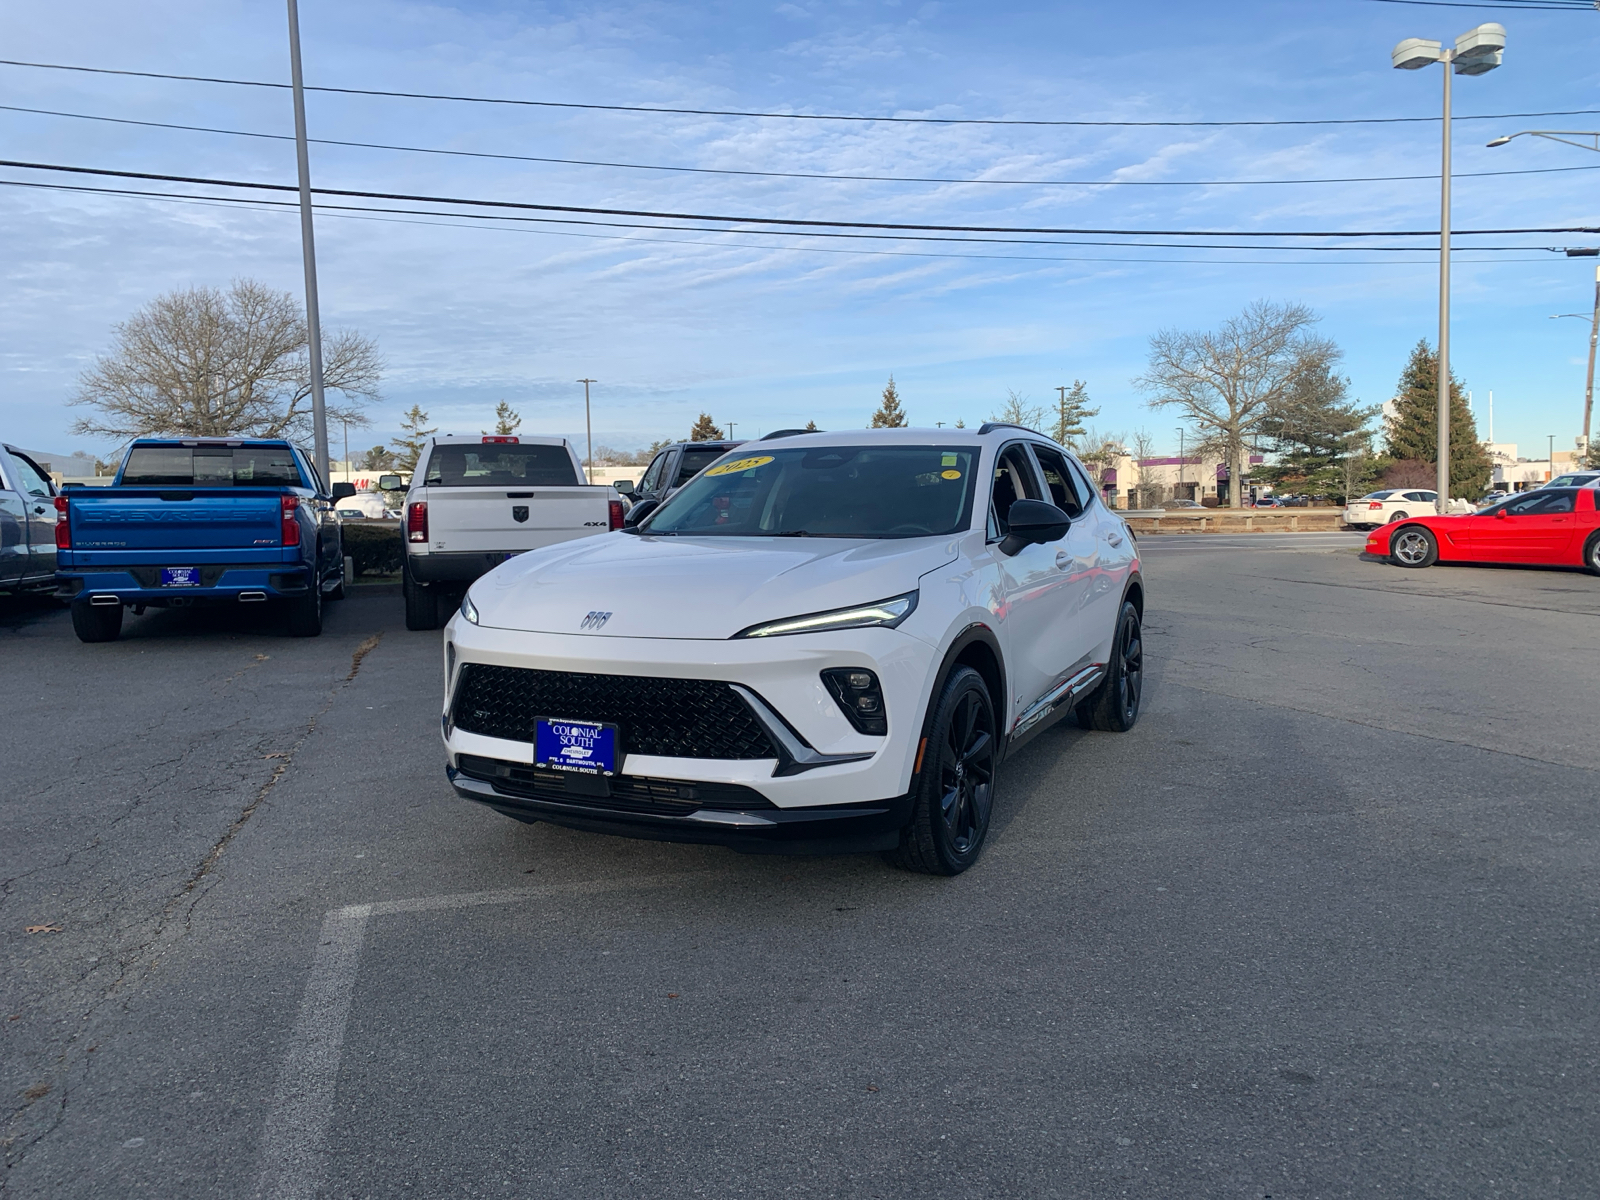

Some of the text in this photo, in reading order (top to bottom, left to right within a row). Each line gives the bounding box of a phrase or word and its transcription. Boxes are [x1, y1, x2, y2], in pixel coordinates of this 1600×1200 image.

[85, 510, 268, 521] CHEVROLET
[553, 725, 601, 739] COLONIAL
[560, 735, 594, 748] SOUTH
[563, 748, 590, 756] CHEVROLET
[552, 764, 598, 775] COLONIAL SOUTH
